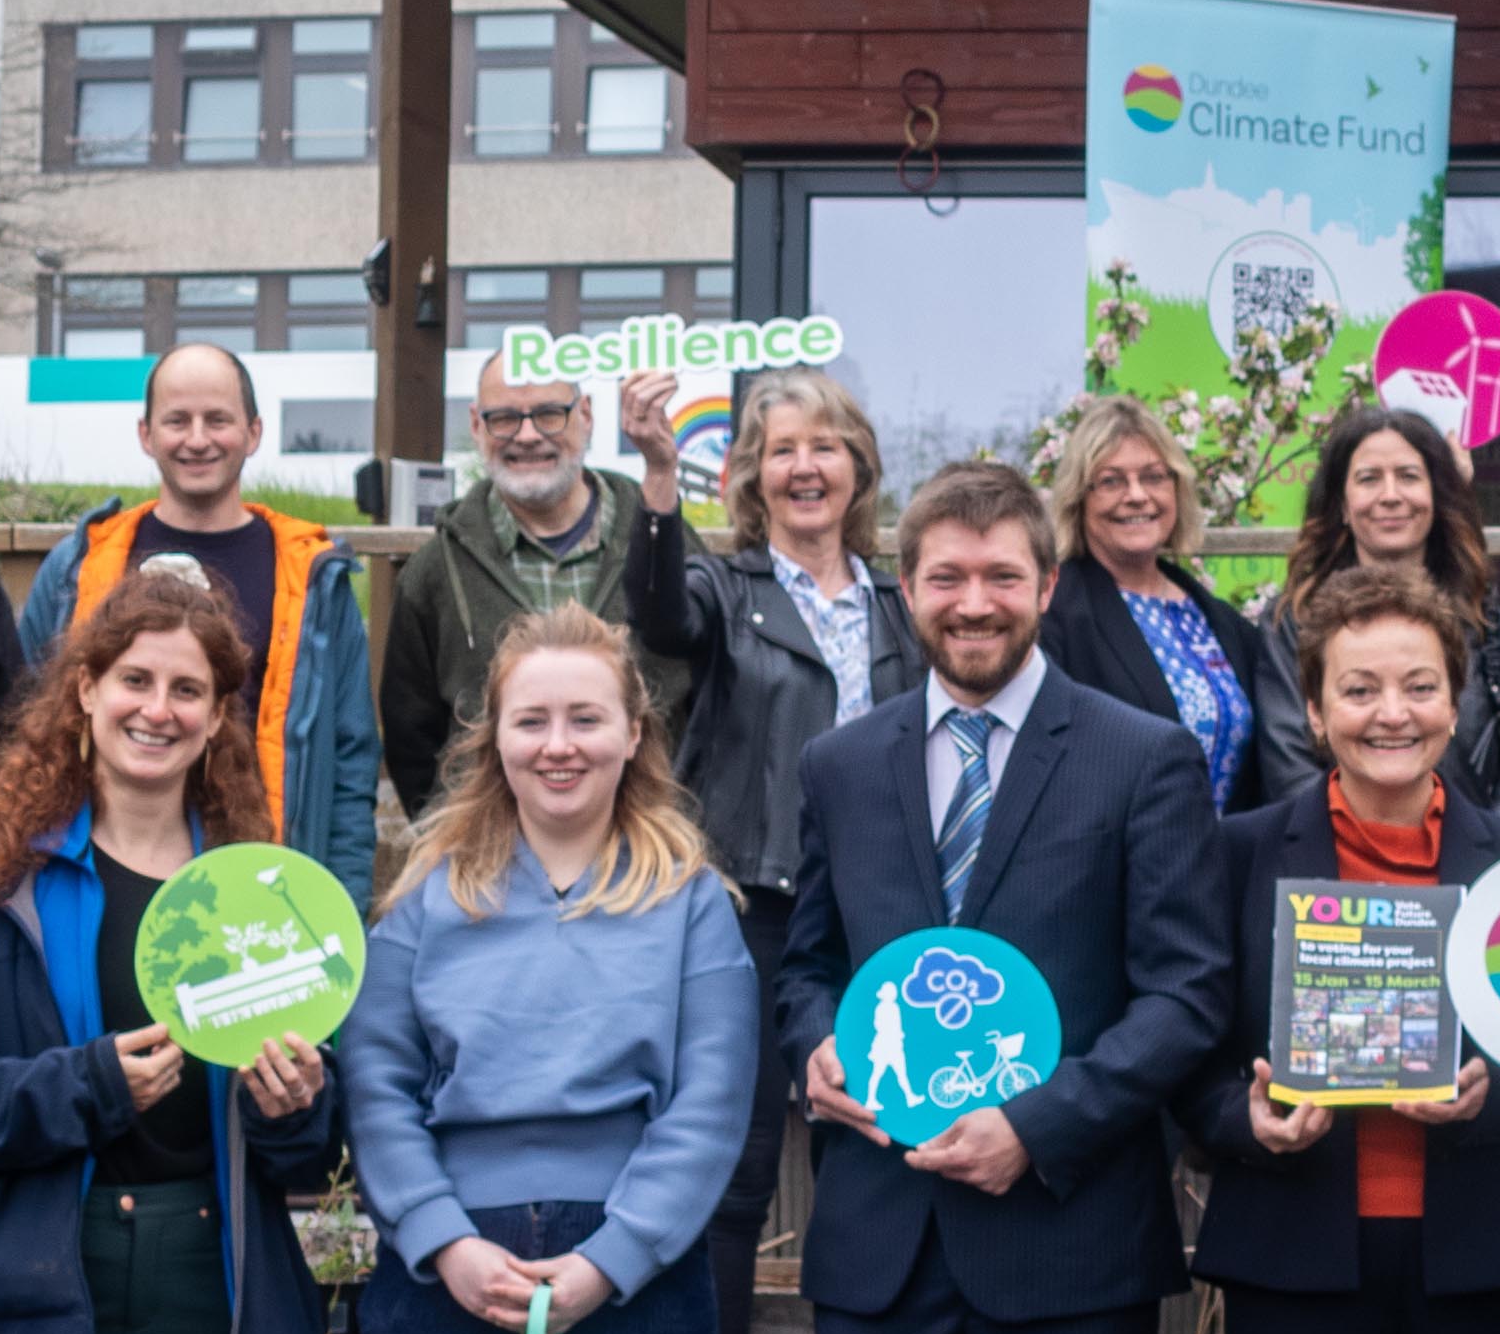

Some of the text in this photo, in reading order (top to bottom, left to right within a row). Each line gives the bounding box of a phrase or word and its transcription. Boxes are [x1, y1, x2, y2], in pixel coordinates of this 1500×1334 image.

[1188, 72, 1269, 100] Dundee
[1188, 101, 1427, 156] Climate Fund
[510, 320, 837, 378] Resilience
[1289, 893, 1394, 927] YOUR
[1299, 952, 1436, 970] local climate project
[1300, 941, 1414, 956] to voting for your
[1294, 971, 1313, 986] 15
[1315, 973, 1349, 987] Jan
[1364, 974, 1383, 988] 15
[1386, 975, 1441, 988] March
